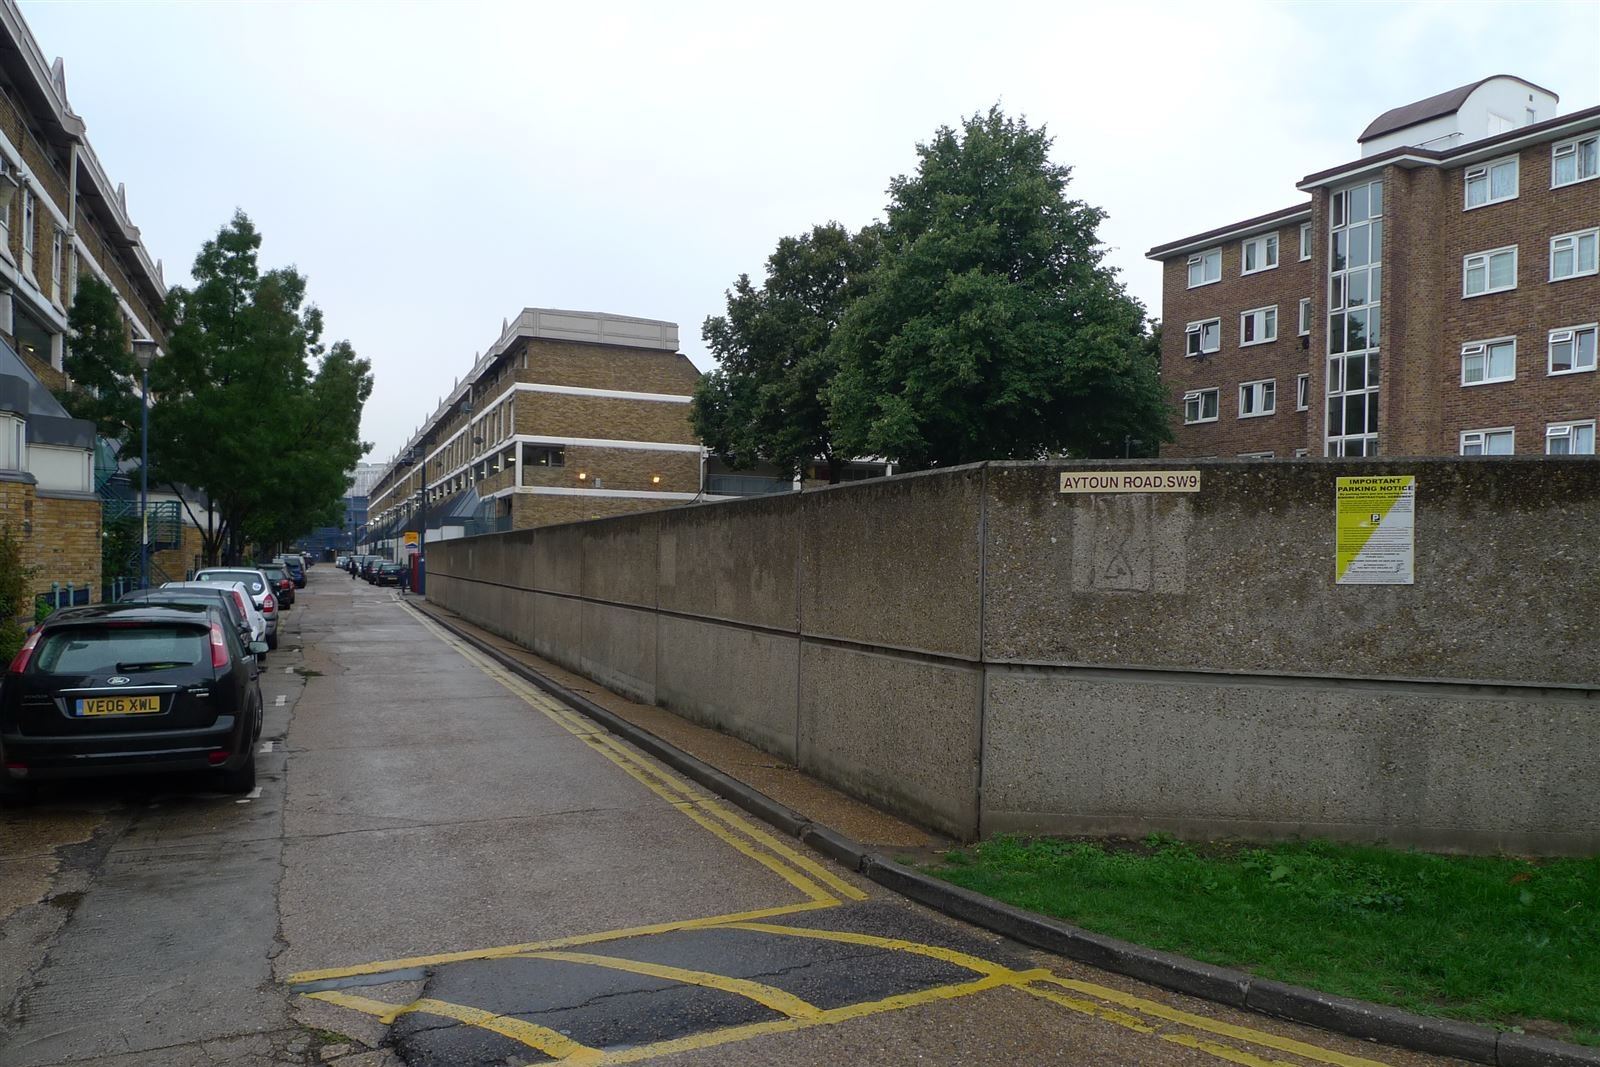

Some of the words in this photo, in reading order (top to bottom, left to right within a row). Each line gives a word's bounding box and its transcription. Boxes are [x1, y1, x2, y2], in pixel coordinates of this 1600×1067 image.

[1064, 477, 1119, 489] AYTOUN
[87, 699, 125, 713] VE06
[129, 698, 157, 712] XWL
